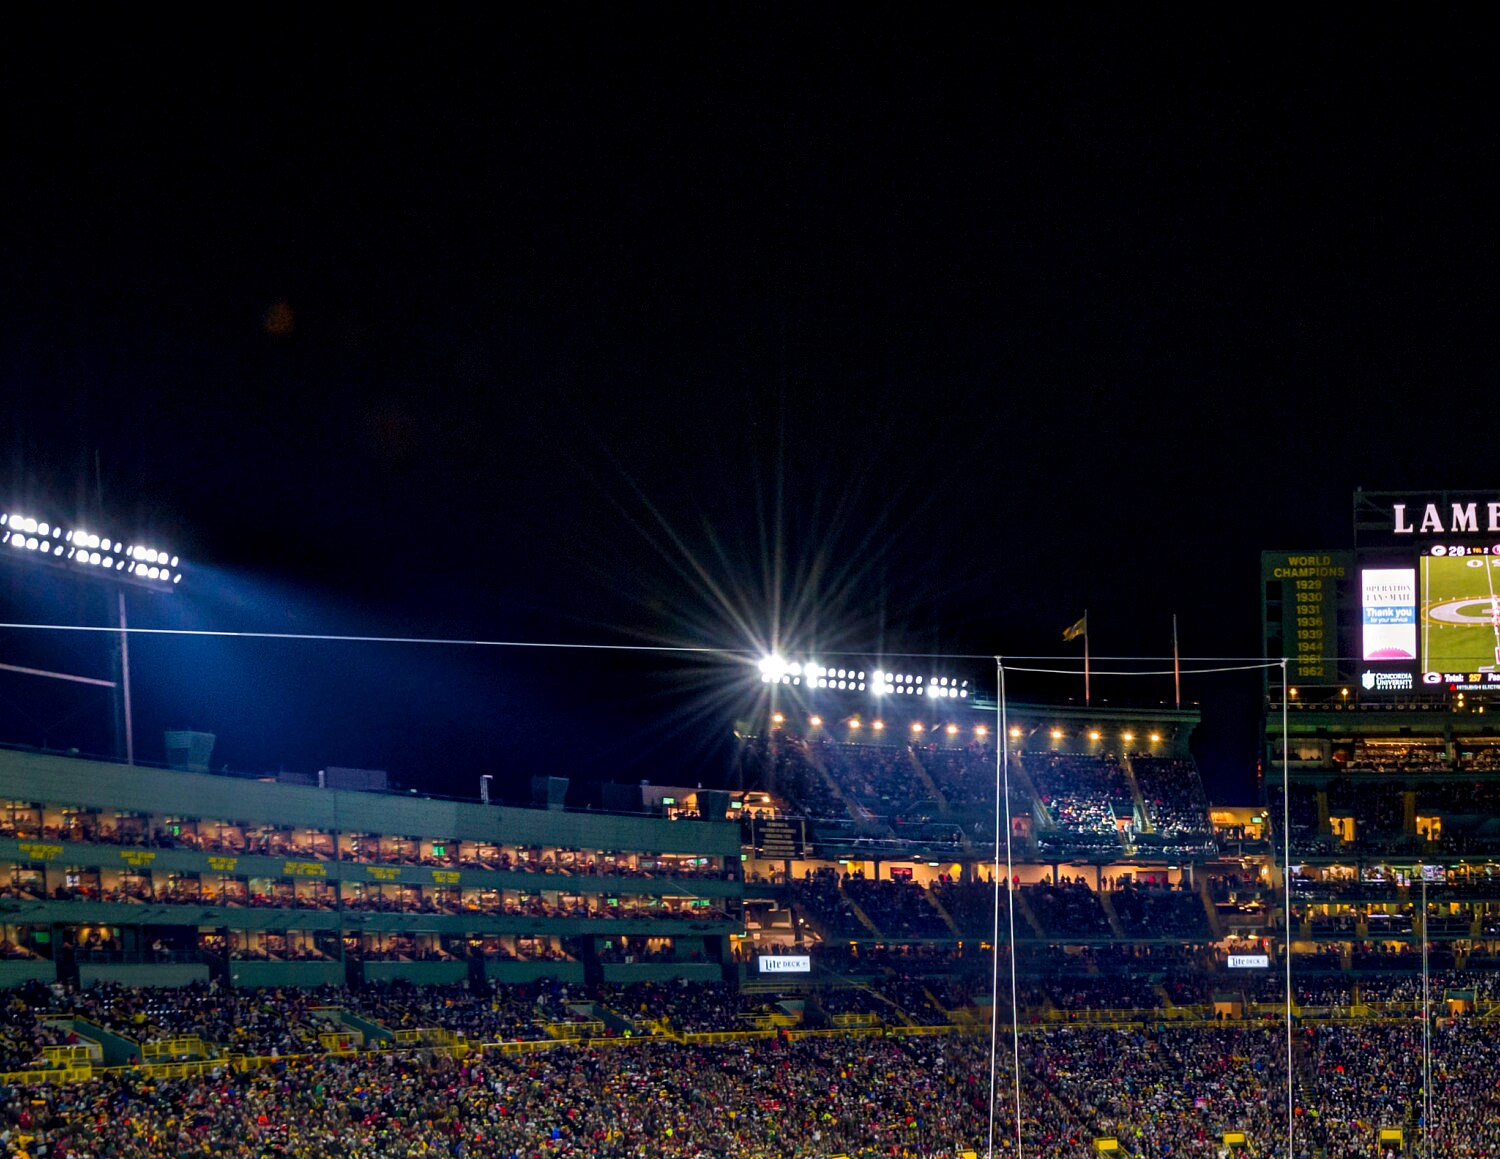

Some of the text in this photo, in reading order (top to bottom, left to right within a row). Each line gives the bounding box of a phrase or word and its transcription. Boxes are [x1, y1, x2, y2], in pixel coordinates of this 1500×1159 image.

[1448, 546, 1465, 557] 20
[1288, 556, 1331, 567] WORLD
[1274, 568, 1345, 577] CHAMPIONS
[1296, 580, 1322, 589] 1929
[1296, 592, 1322, 602] 1930
[1296, 605, 1320, 614] 1931
[1366, 607, 1412, 618] Thank you
[1297, 667, 1324, 676] 1962
[1444, 673, 1464, 682] Total:
[1468, 673, 1482, 682] 257
